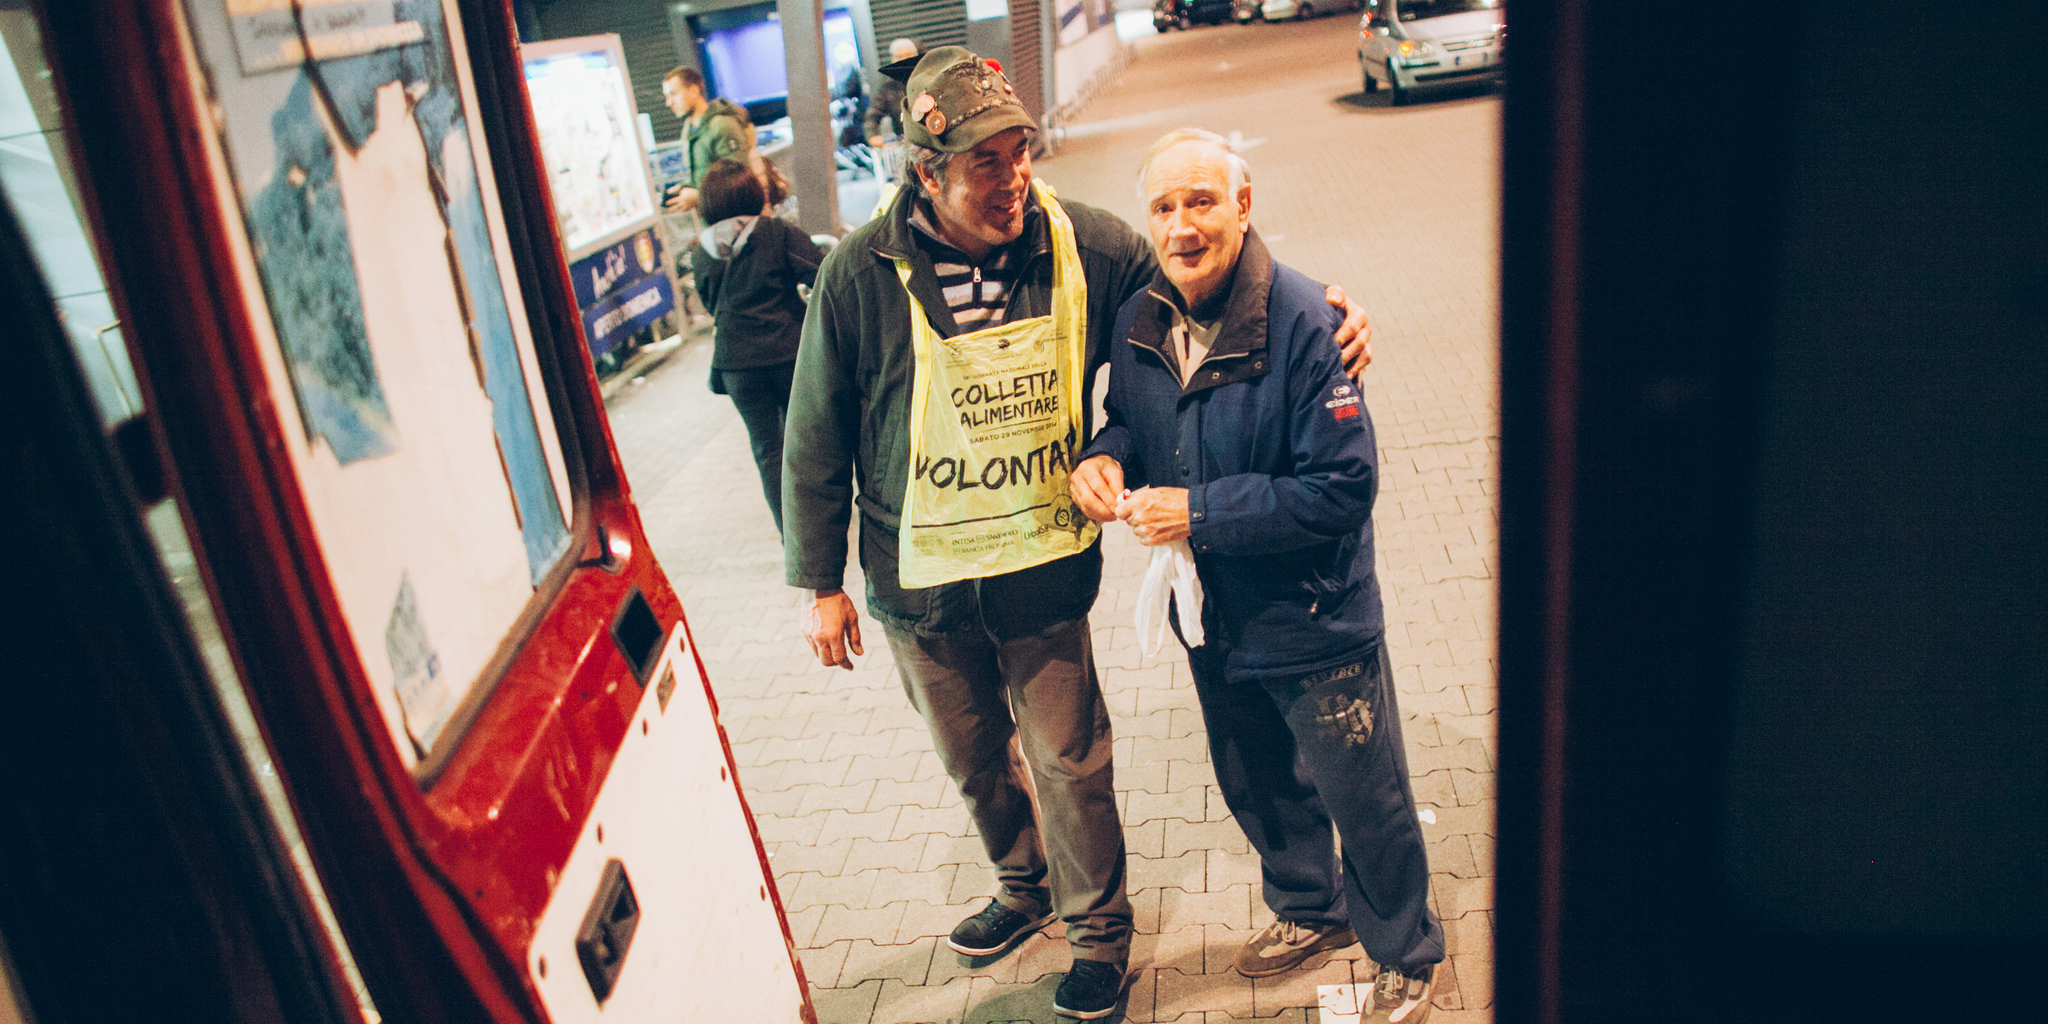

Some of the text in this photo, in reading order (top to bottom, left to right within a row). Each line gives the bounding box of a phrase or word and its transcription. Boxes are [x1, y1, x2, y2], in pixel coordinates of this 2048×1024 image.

[1001, 365, 1031, 374] NAZIONALE
[1031, 361, 1047, 369] DELLA
[951, 369, 1058, 408] COLLETTA
[961, 395, 1058, 430] ALIMENTARE
[970, 433, 1000, 444] SABATO
[1001, 430, 1010, 438] 29
[1011, 424, 1045, 437] NOVEMBRE
